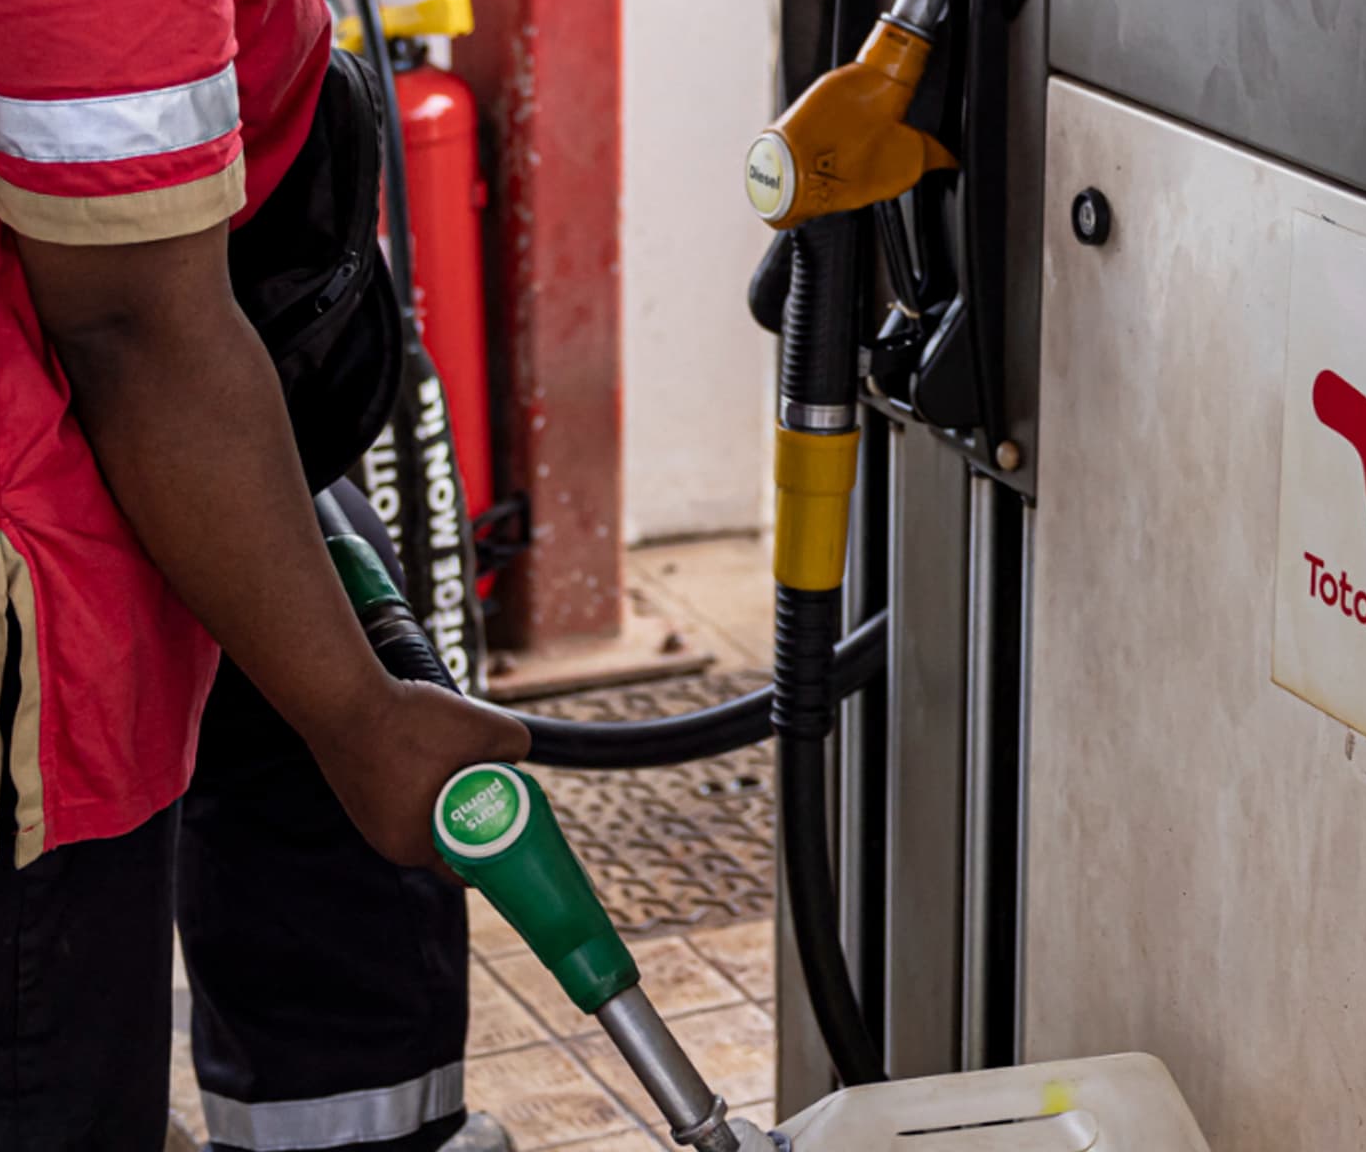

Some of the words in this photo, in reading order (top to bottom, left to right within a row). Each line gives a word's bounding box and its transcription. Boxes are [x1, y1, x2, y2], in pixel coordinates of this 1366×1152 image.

[749, 163, 781, 190] Diesel
[424, 441, 461, 550] MON
[450, 777, 505, 823] plomb
[466, 799, 506, 831] sans
